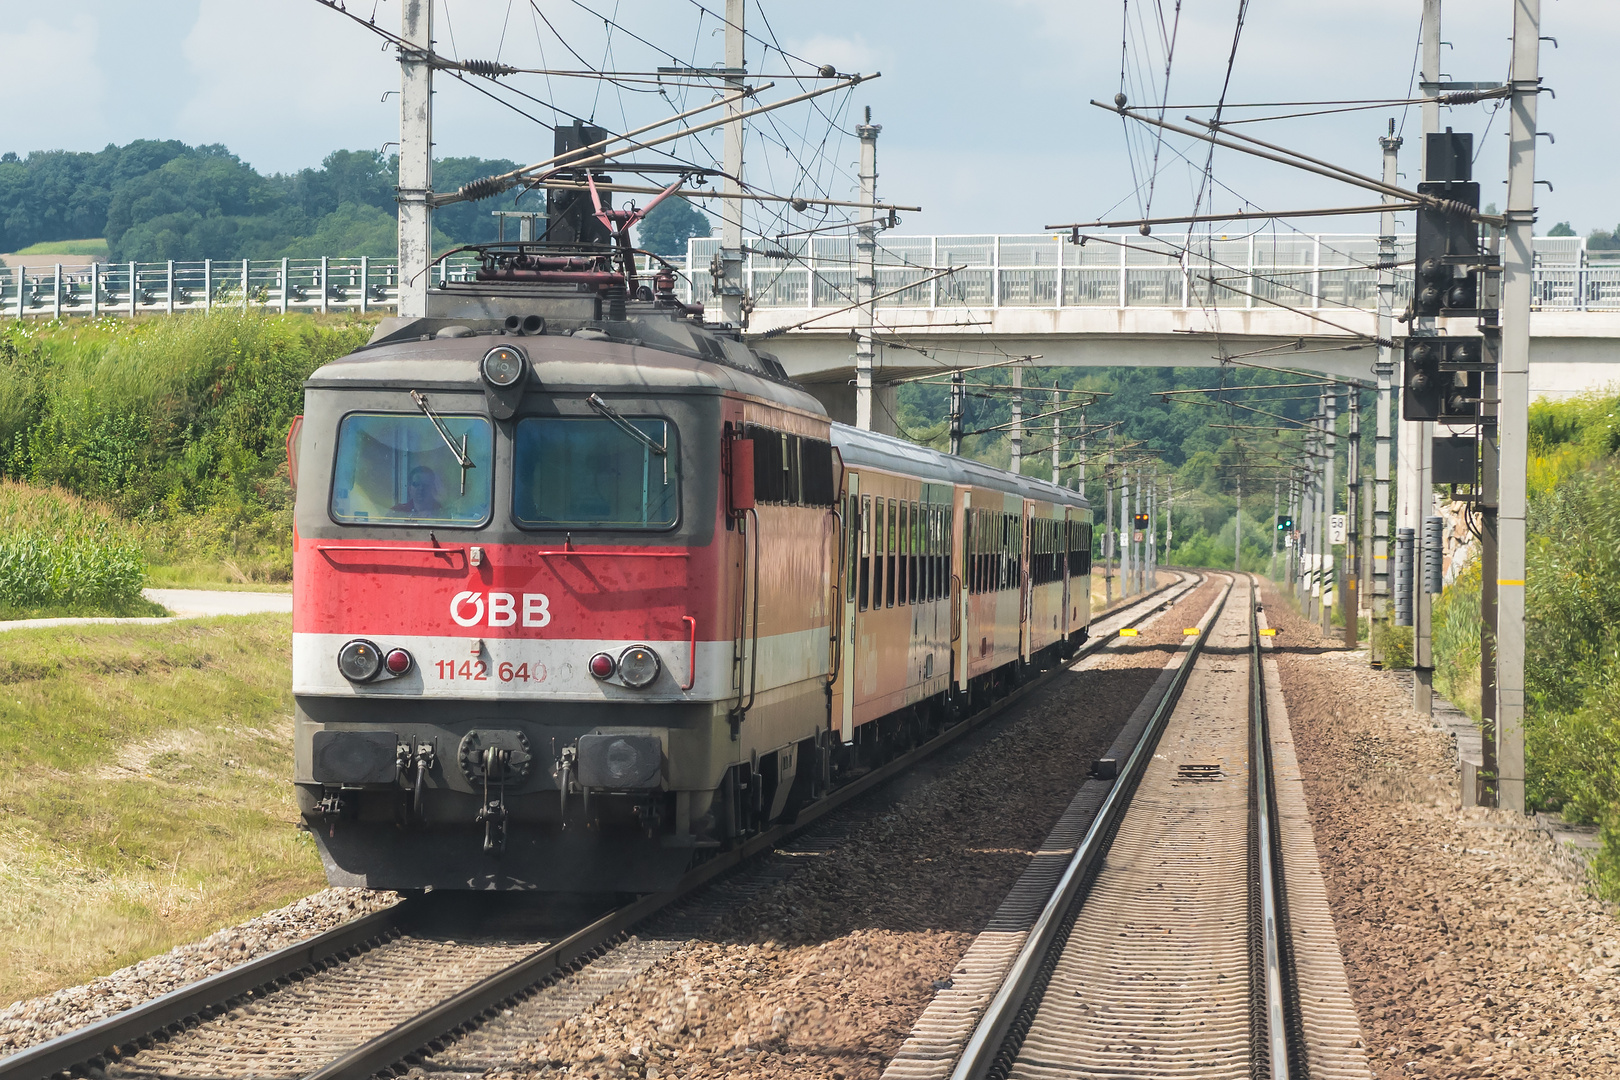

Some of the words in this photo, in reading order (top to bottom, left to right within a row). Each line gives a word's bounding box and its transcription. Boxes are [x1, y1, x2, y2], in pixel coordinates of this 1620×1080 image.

[1331, 517, 1343, 528] 58
[1334, 530, 1340, 541] 2
[450, 591, 551, 627] ÖBB
[435, 660, 487, 680] 1142
